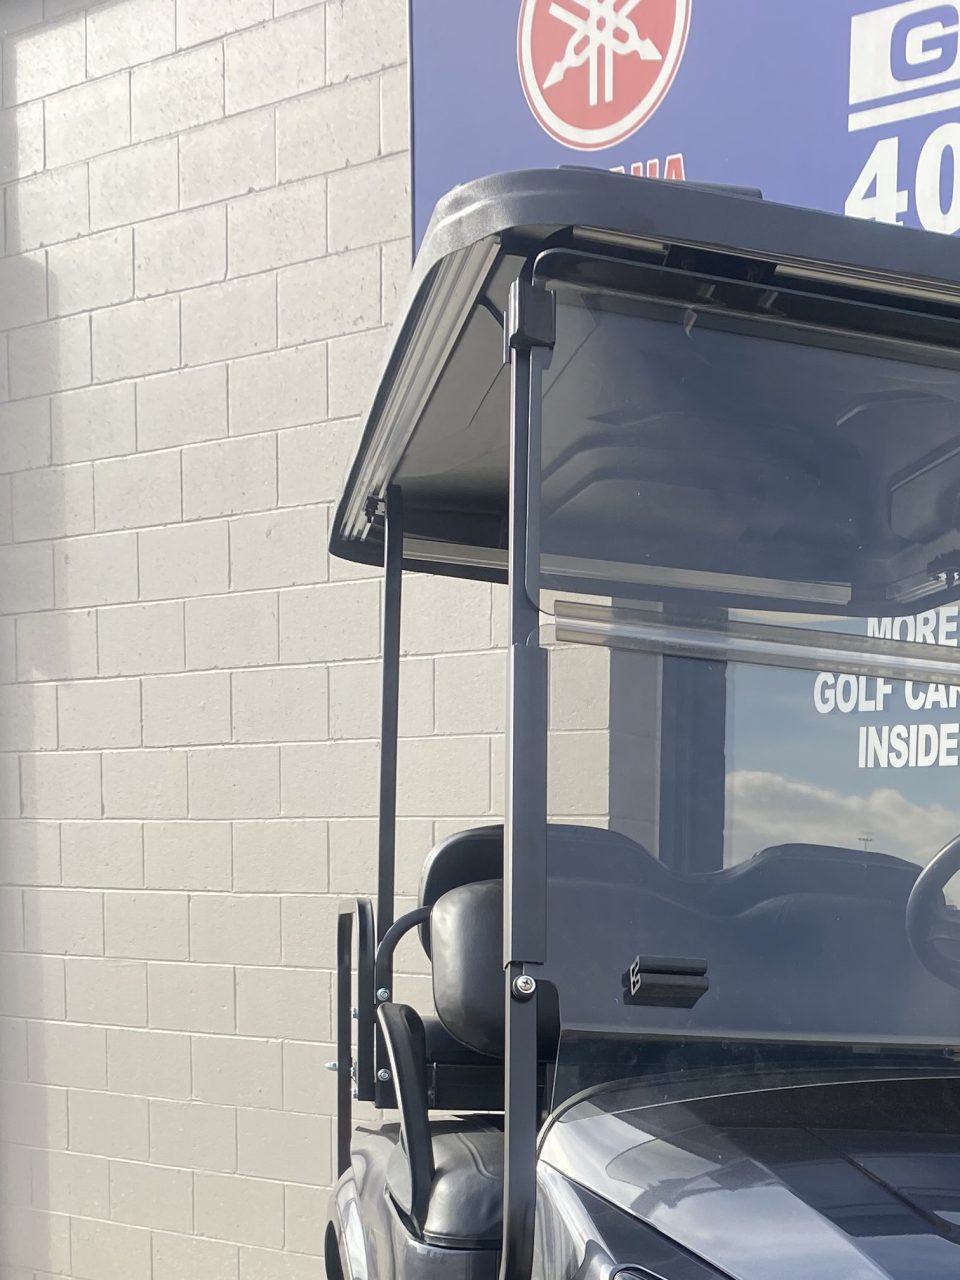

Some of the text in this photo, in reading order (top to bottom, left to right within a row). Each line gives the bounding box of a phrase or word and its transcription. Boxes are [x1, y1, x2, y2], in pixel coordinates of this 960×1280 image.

[866, 606, 959, 646] MORE
[813, 672, 893, 713] GOLF
[858, 723, 960, 768] INSIDE
